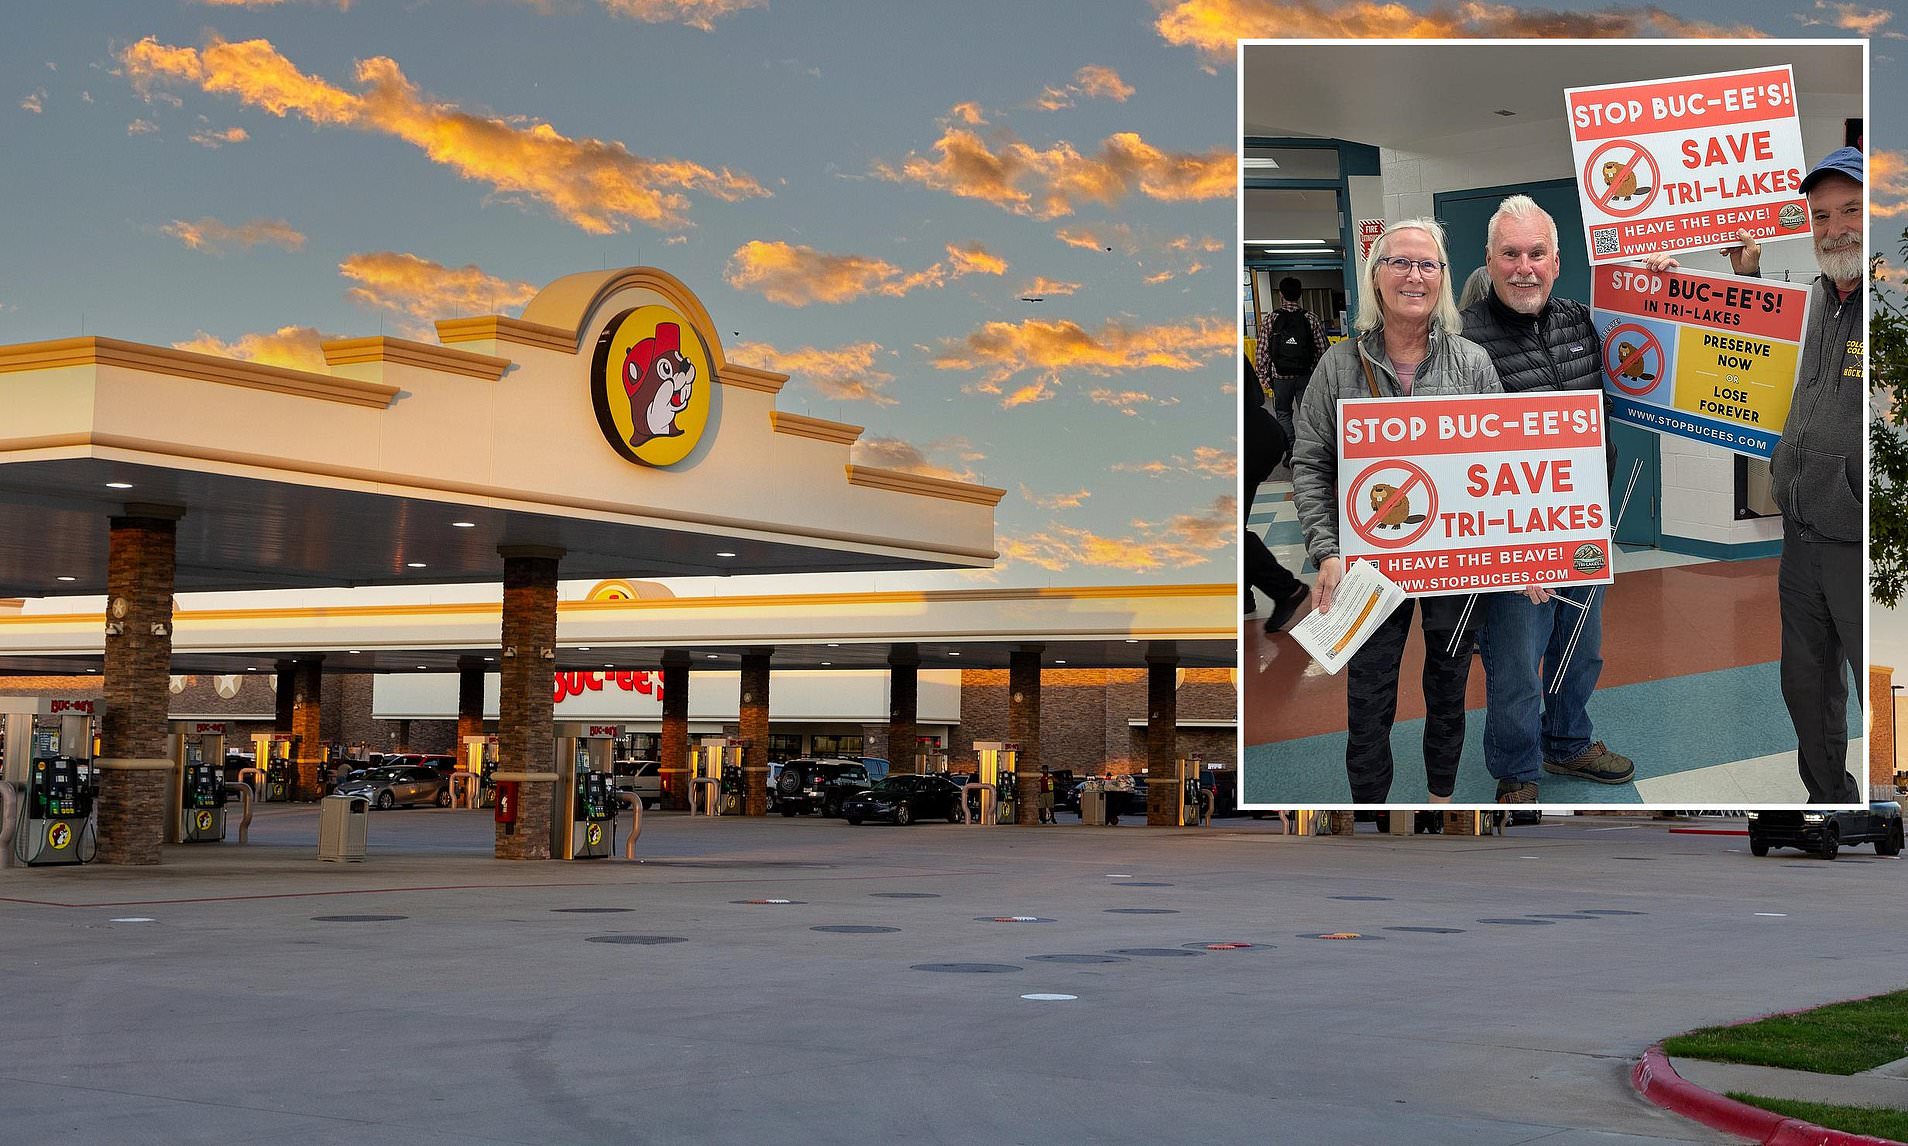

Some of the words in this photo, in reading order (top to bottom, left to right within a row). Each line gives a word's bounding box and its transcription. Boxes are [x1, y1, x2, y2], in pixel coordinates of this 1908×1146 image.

[1575, 100, 1643, 128] STOP
[1652, 82, 1791, 121] BUC-EE'S!
[1681, 130, 1774, 170] SAVE
[1663, 170, 1802, 206] TRI-LAKES
[1365, 225, 1379, 234] FIRE
[1625, 220, 1675, 238] HEAVE
[1680, 215, 1710, 231] THE
[1717, 208, 1771, 226] BEAVE!
[1623, 226, 1776, 254] WWW.STOPBUCEECOM
[1611, 270, 1663, 294] STOP
[1668, 278, 1783, 314] BUC-EE'S!
[1644, 300, 1658, 313] IN
[1664, 303, 1741, 326] TRI-LAKES
[1703, 334, 1771, 357] PRESERVE
[1717, 354, 1753, 371] NOW
[1725, 374, 1740, 384] OR
[1713, 385, 1748, 404] LOSE
[1699, 400, 1760, 423] FOREVER
[1345, 418, 1427, 444] STOP
[1438, 408, 1598, 440] BUC-EE'S!
[1627, 407, 1768, 450] WWW.STOPBUCEES.COM
[1466, 459, 1574, 498] SAVE
[1440, 503, 1604, 538] TRI-LAKES
[1388, 555, 1449, 572] HEAVE
[1456, 552, 1492, 567] THE
[1500, 546, 1564, 564] BEAVE!
[1394, 568, 1569, 591] WW.STOPBUCEES.COM
